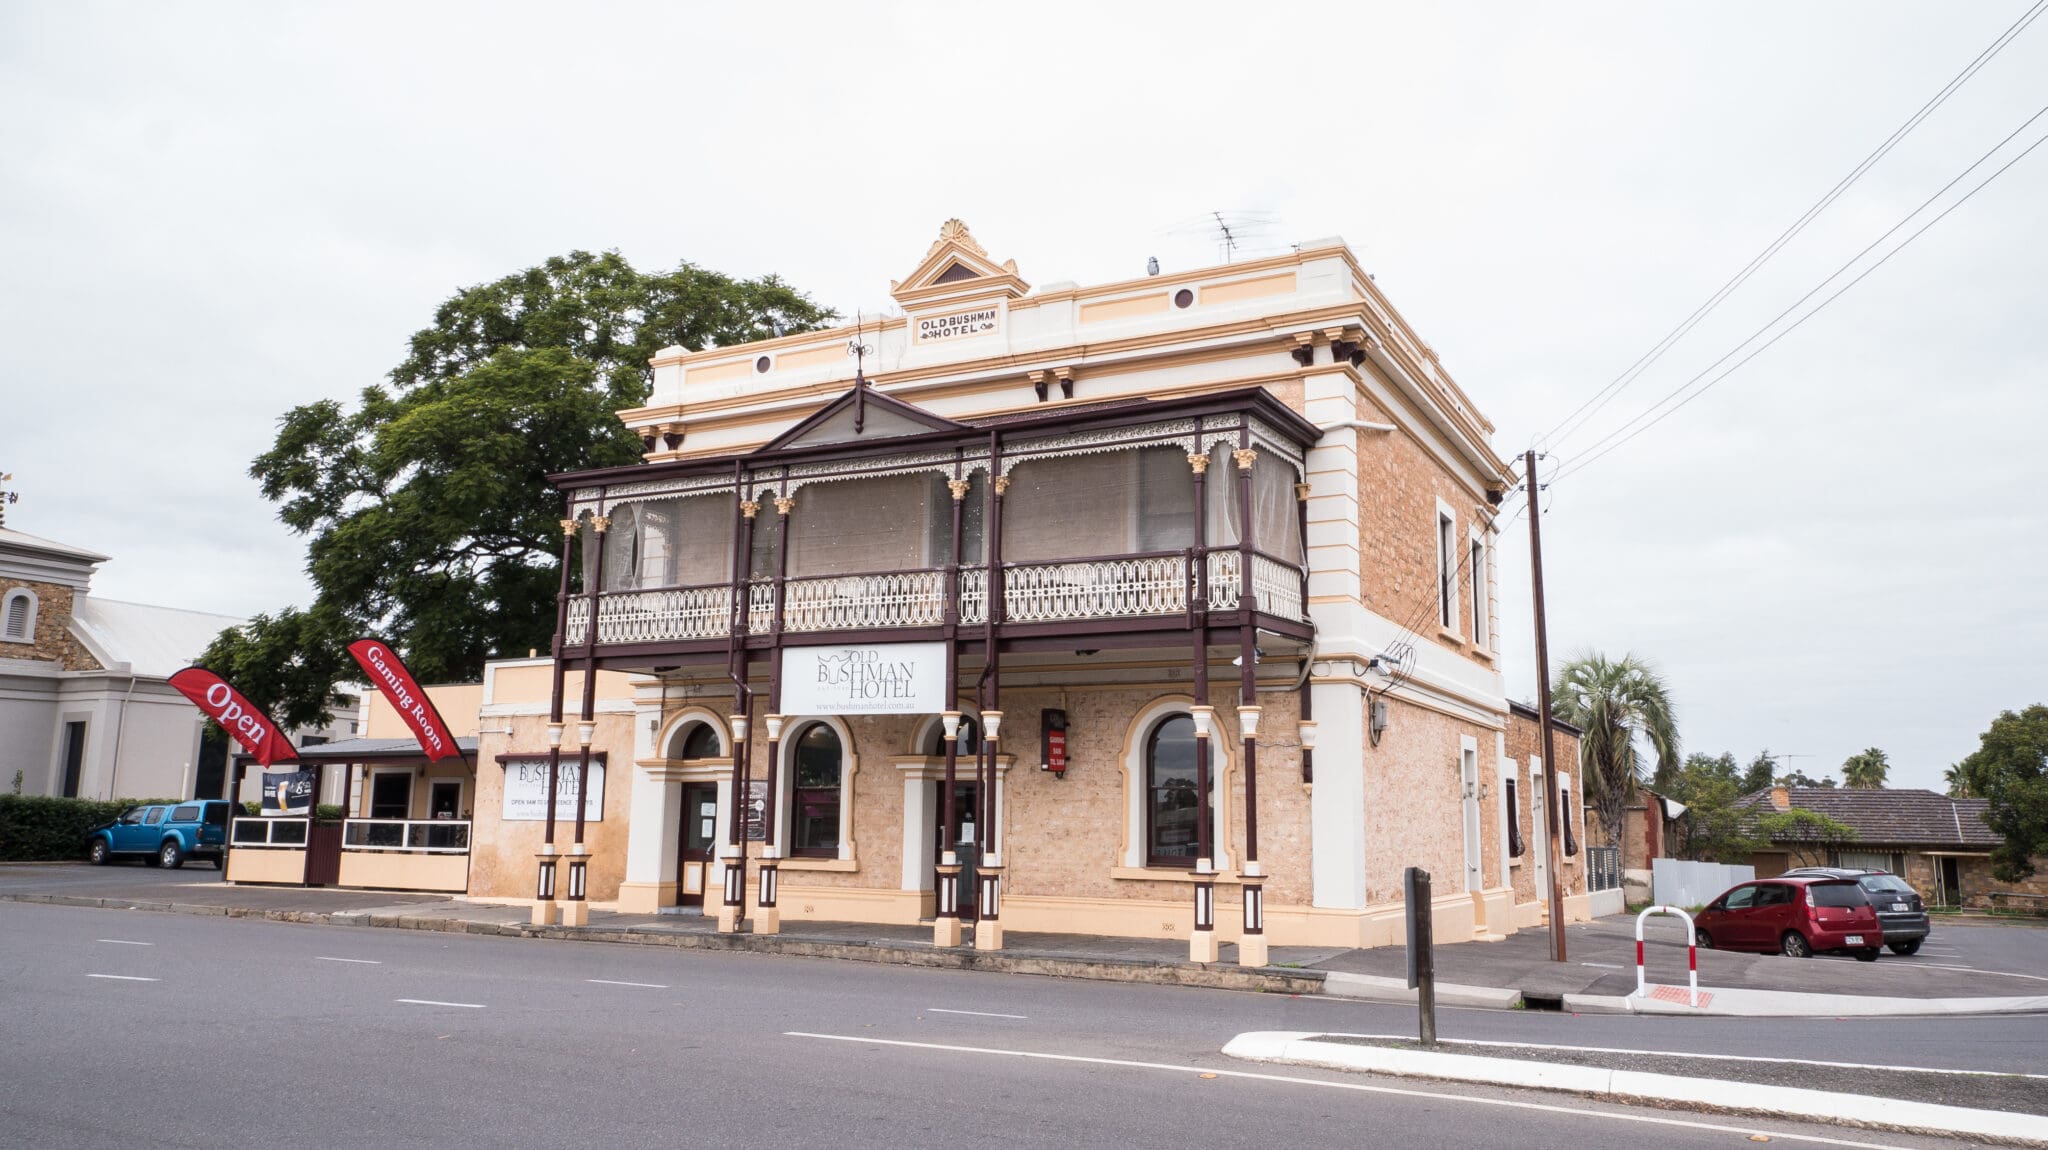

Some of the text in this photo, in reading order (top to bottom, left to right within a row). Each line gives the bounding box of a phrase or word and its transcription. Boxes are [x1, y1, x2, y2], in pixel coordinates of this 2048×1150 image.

[921, 310, 996, 330] OLD BUSHMAN
[934, 324, 978, 339] HOTEL
[850, 650, 879, 664] OLD
[817, 661, 915, 684] BUSHMAN
[367, 646, 443, 751] Gaming Room
[849, 679, 916, 699] HOTEL
[206, 683, 266, 745] Open
[816, 700, 915, 712] www.bushmanhotel.com.au
